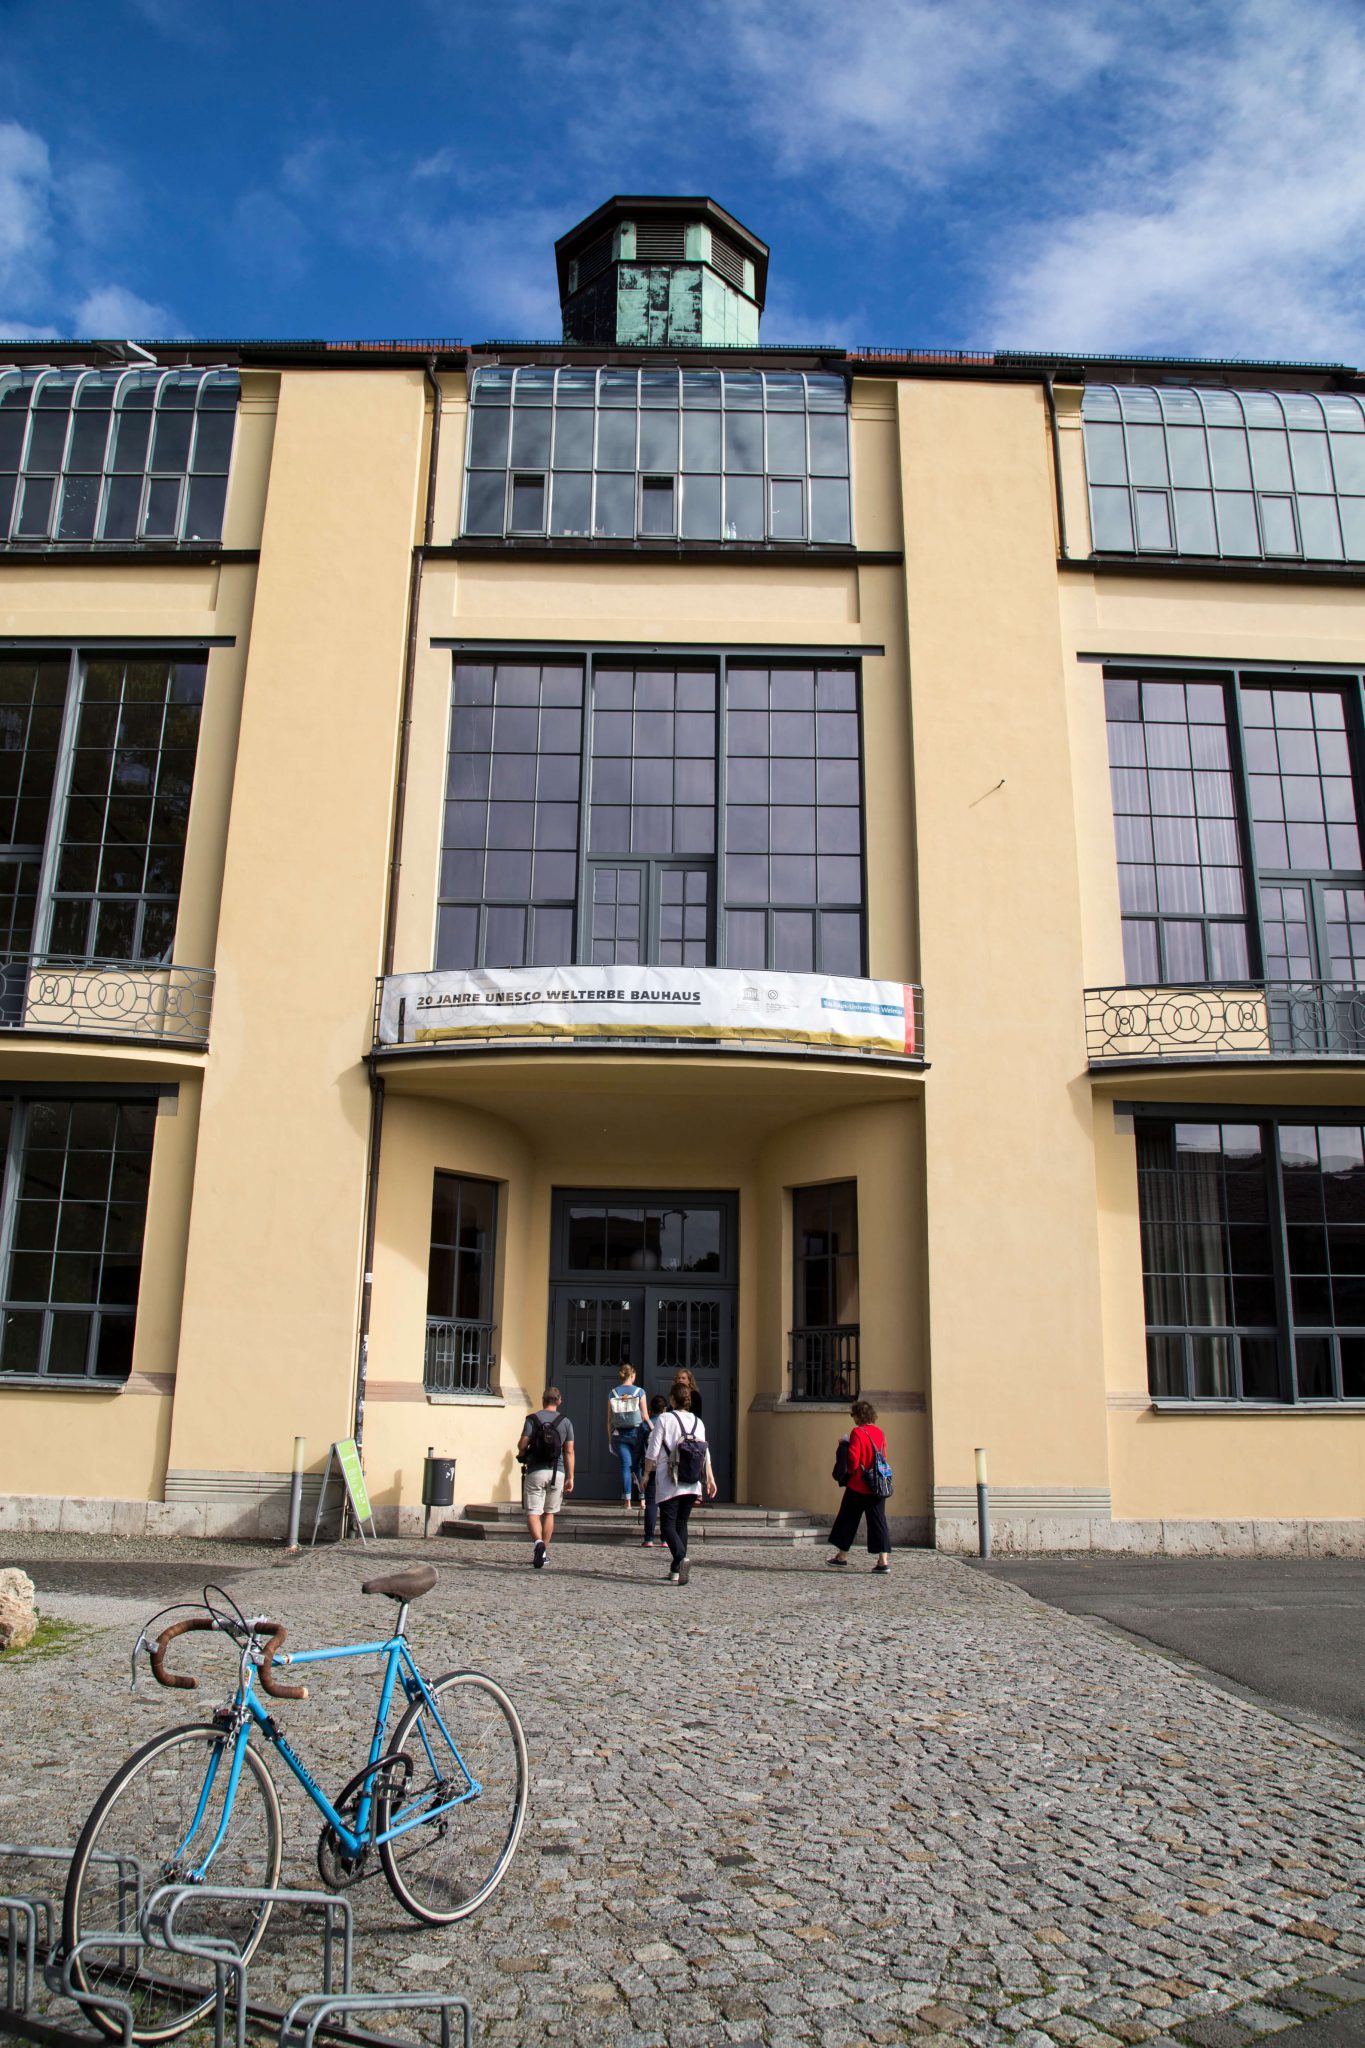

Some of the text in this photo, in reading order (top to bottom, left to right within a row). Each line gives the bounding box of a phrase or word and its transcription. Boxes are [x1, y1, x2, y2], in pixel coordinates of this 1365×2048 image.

[417, 989, 701, 1006] 20 JAHRE UNESCO WELTERBE BAUHAUS
[880, 1006, 904, 1015] Weimar
